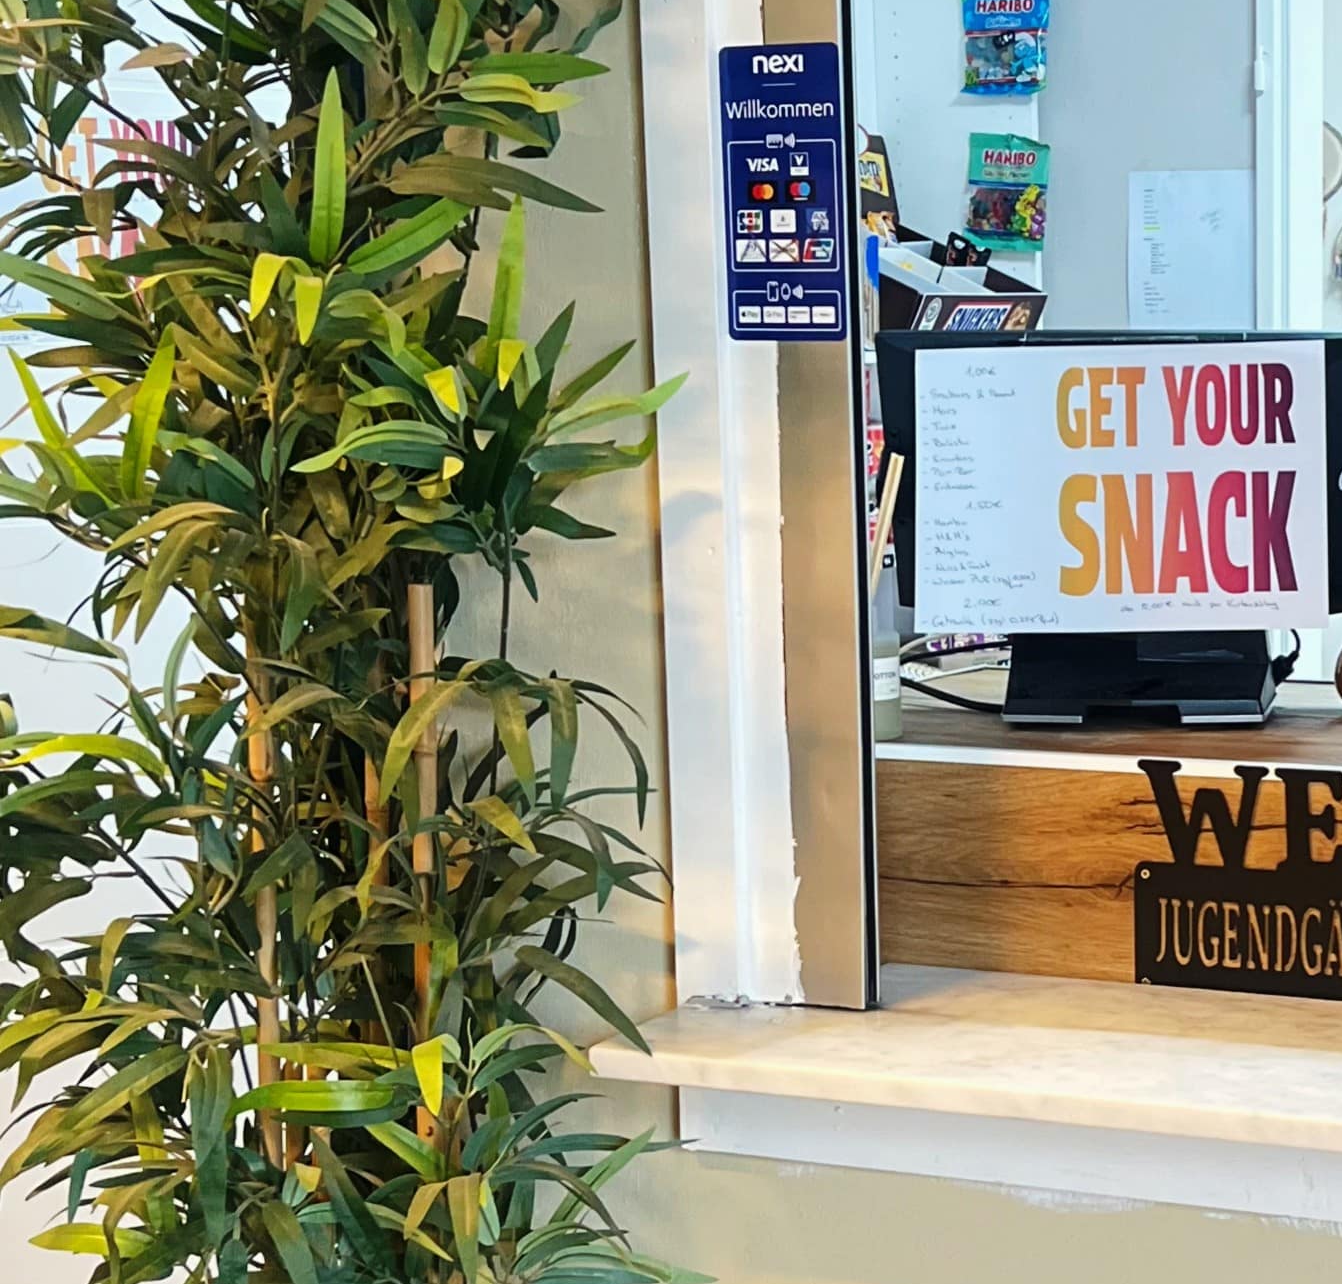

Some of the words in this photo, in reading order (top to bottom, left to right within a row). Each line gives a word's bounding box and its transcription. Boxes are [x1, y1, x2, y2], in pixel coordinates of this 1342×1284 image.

[752, 54, 804, 75] nexi
[725, 99, 834, 120] Willkommen
[745, 158, 780, 172] VISA
[984, 150, 1037, 166] HARIBO
[1057, 367, 1146, 449] GET
[1163, 363, 1296, 447] YOUR
[1059, 471, 1298, 596] SNACK
